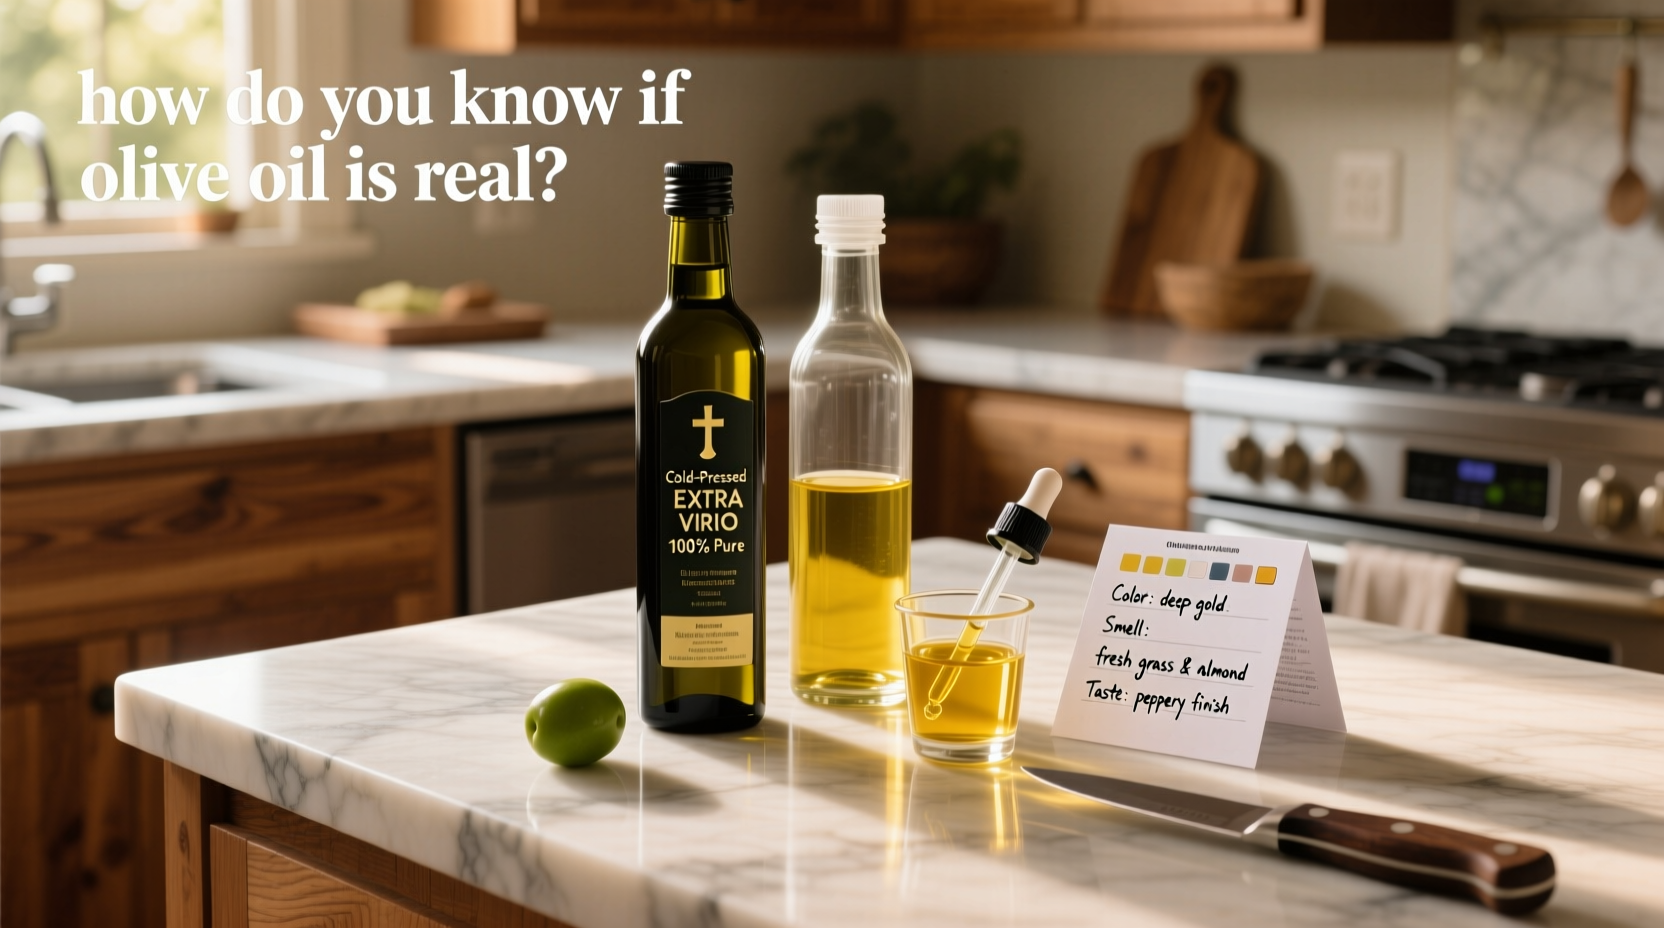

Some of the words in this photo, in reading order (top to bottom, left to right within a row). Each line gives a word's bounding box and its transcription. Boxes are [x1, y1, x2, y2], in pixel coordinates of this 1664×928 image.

[665, 468, 747, 484] Cold-Pressed
[674, 488, 744, 509] EXTRA
[679, 511, 739, 532] VIRIO
[668, 538, 710, 554] 100%
[714, 538, 745, 553] Pure
[1111, 583, 1154, 605] Color:
[1160, 589, 1192, 616] deep
[1102, 615, 1150, 637] Smell:
[1095, 645, 1132, 668] fresh
[1134, 655, 1174, 681] grass
[1180, 657, 1192, 676] &
[1197, 659, 1249, 681] almond
[1086, 680, 1129, 702] Taste:
[1133, 691, 1187, 720] peppery
[1191, 692, 1230, 714] finish
